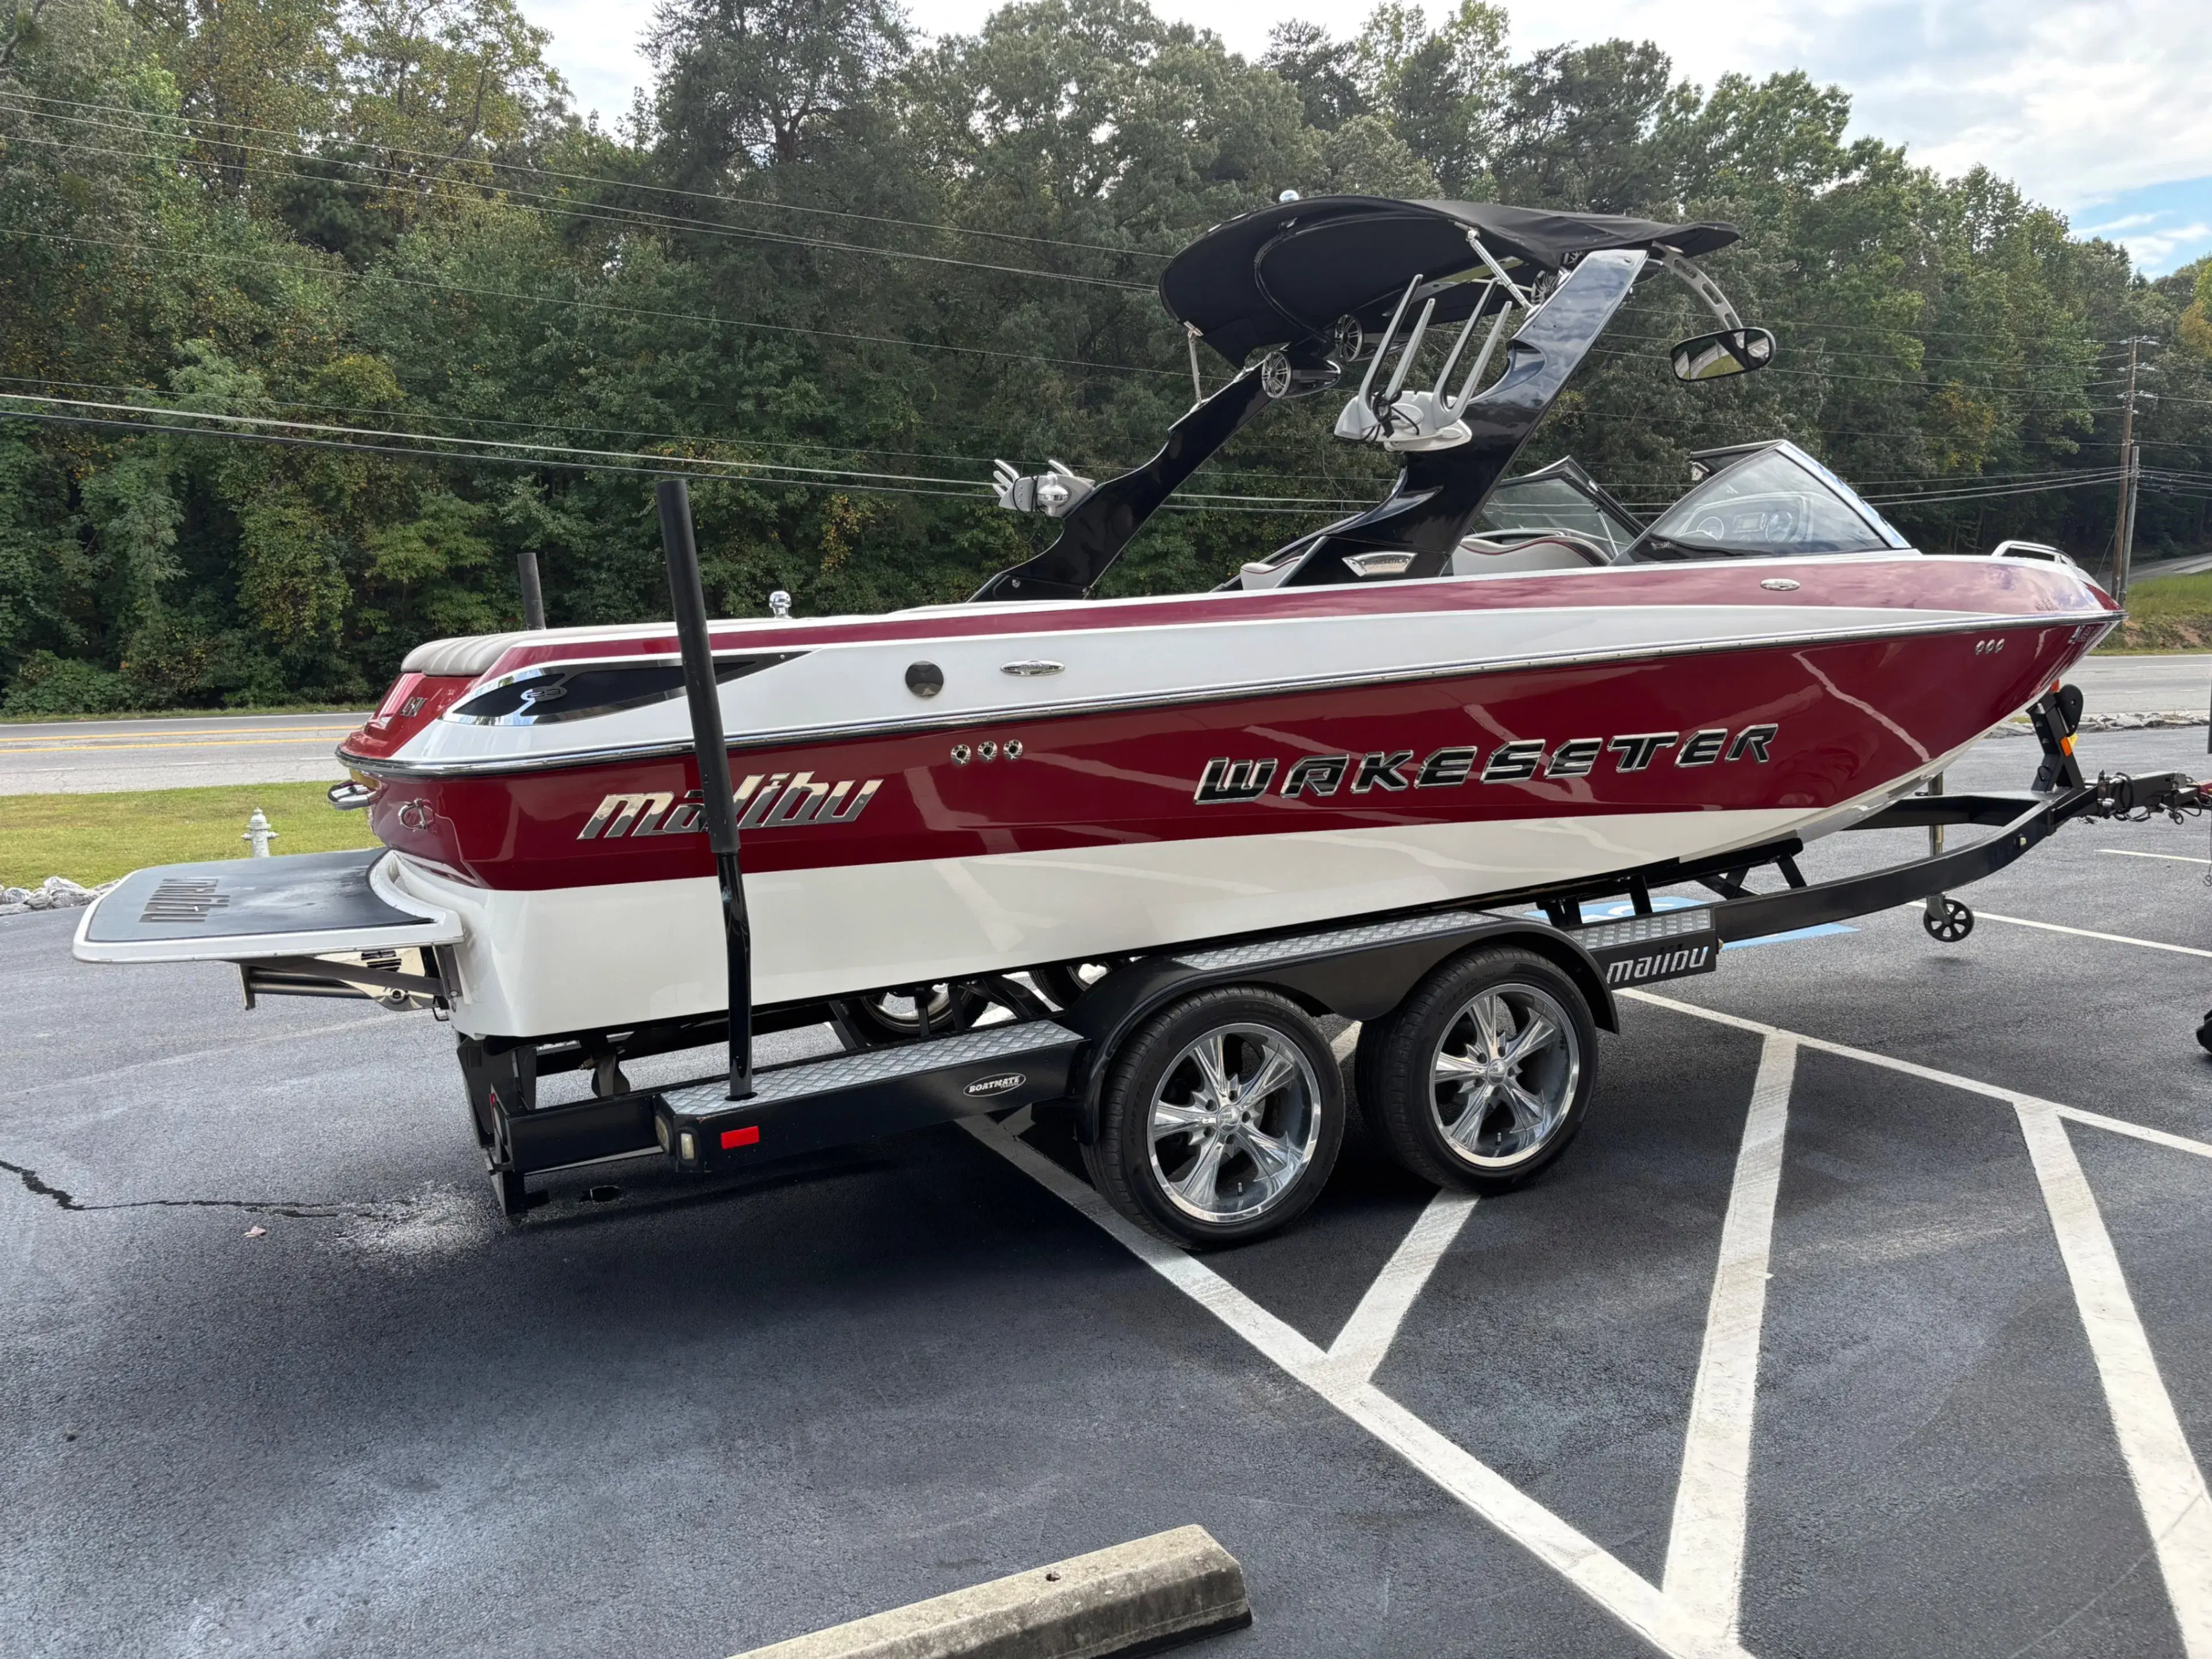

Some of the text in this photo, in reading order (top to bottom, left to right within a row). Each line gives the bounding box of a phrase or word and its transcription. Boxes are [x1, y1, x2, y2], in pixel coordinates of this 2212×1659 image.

[1193, 722, 1778, 805] WAKESETTER
[576, 770, 884, 840] malibu
[1606, 943, 1709, 984] malibu
[969, 1076, 1020, 1093] BOATMATE
